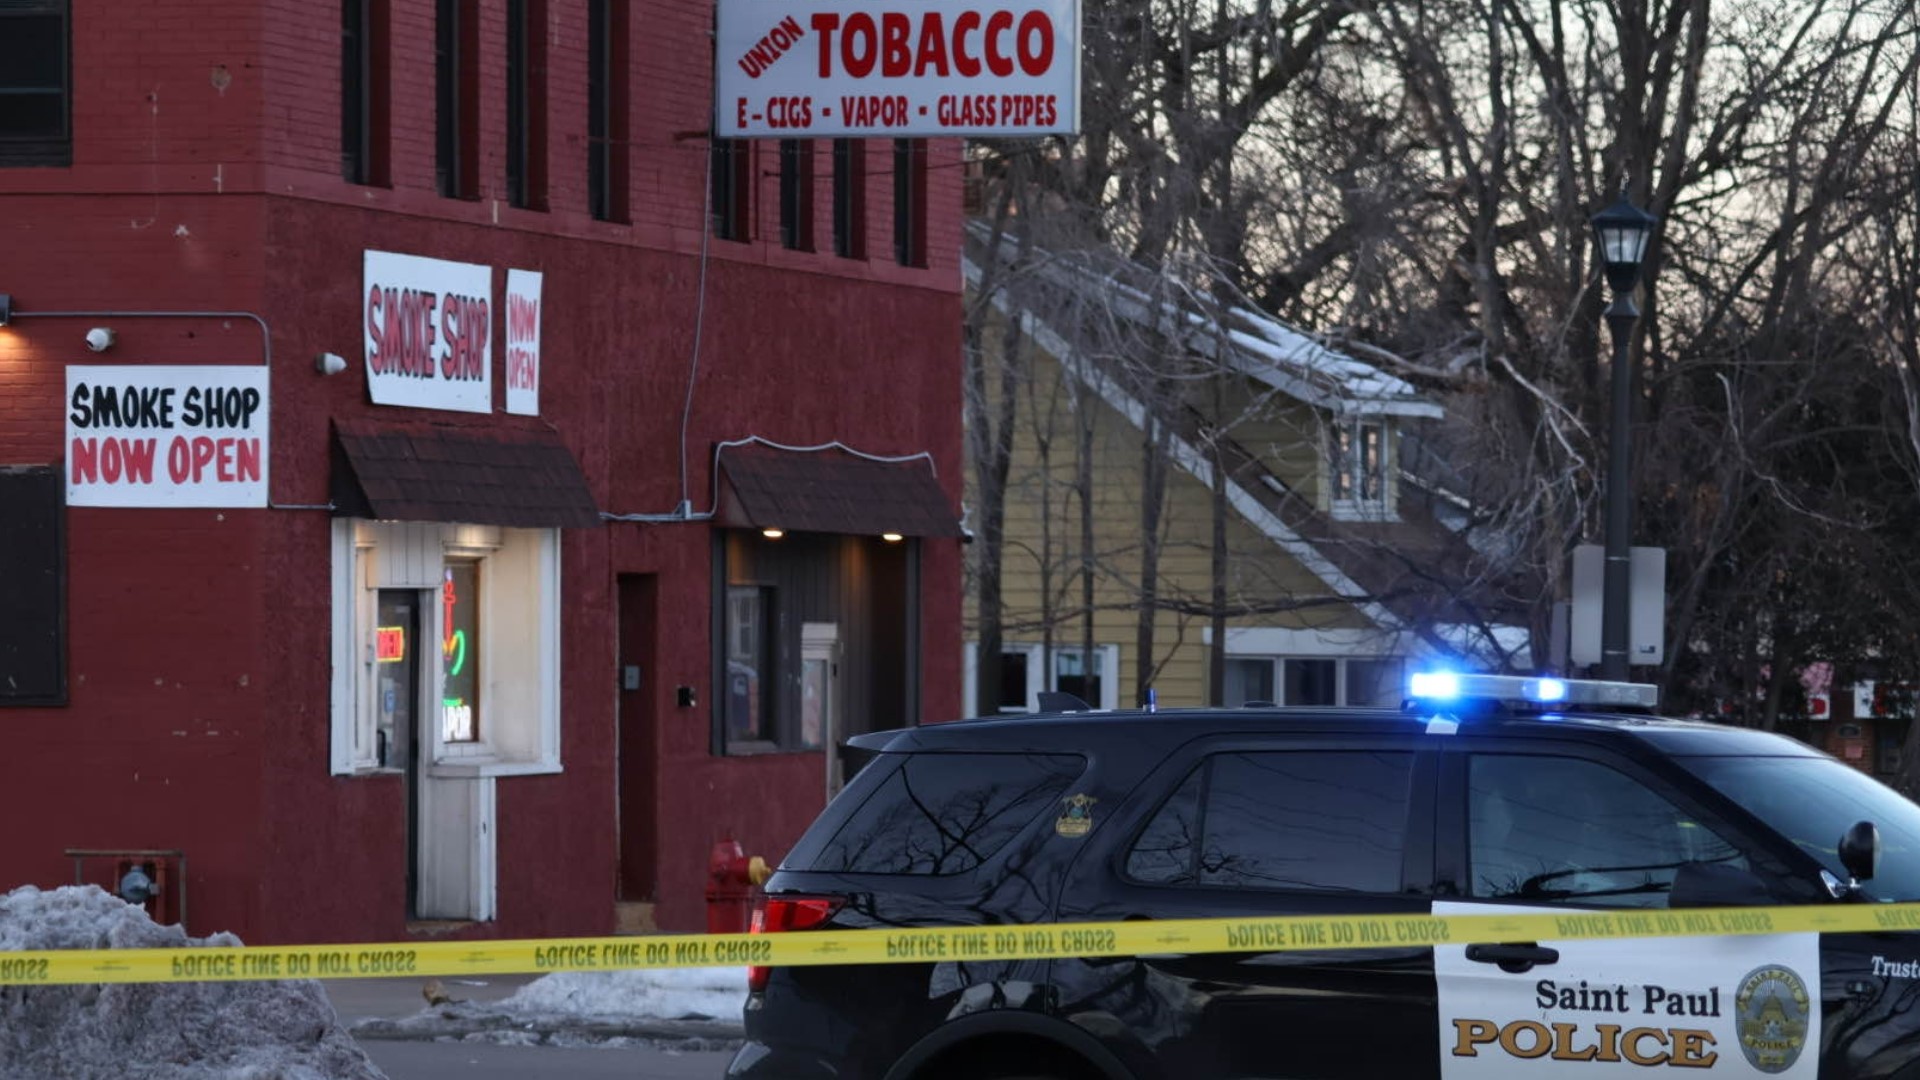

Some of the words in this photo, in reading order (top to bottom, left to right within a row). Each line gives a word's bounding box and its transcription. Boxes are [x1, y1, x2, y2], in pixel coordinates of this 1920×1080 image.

[738, 15, 804, 78] UNION
[811, 10, 1055, 78] TOBACCO
[841, 96, 909, 127] VAPOR
[938, 95, 997, 127] GLASS
[1001, 95, 1057, 127] PIPES
[368, 283, 437, 380] SMOKE
[441, 292, 489, 382] SHOP
[509, 293, 537, 344] NOW
[509, 347, 536, 391] OPEN
[70, 382, 175, 430] SMOKE
[182, 386, 260, 430] SHOP
[71, 437, 156, 485] NOW
[168, 436, 260, 485] OPEN
[1871, 955, 1920, 978] Trust
[1536, 979, 1629, 1012] Saint
[1642, 985, 1721, 1017] Paul
[1452, 1018, 1718, 1069] POLICE
